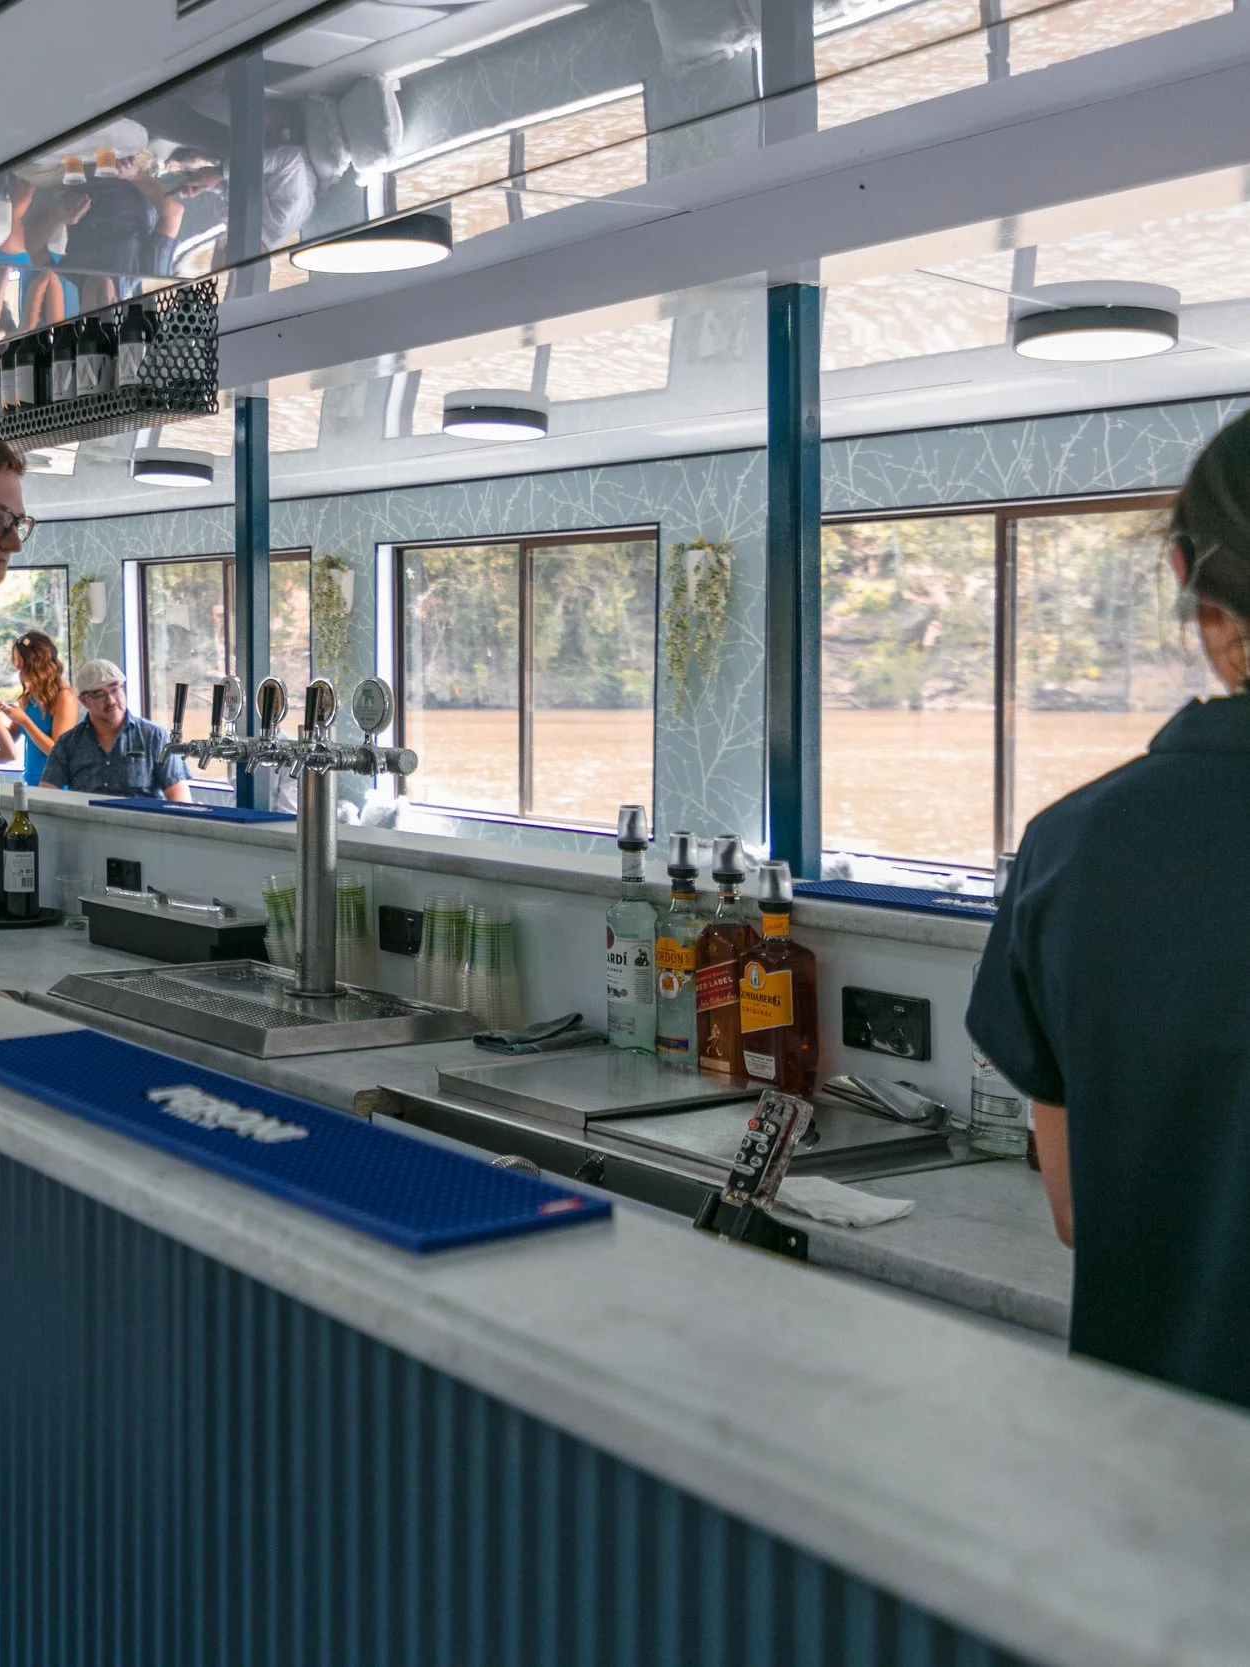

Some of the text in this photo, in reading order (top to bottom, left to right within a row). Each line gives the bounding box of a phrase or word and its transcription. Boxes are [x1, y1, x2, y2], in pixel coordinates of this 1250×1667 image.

[607, 952, 627, 966] ARDÍ
[709, 976, 733, 988] LABEL
[740, 991, 781, 1007] UNDABERG
[742, 1006, 773, 1017] ORIGINAL
